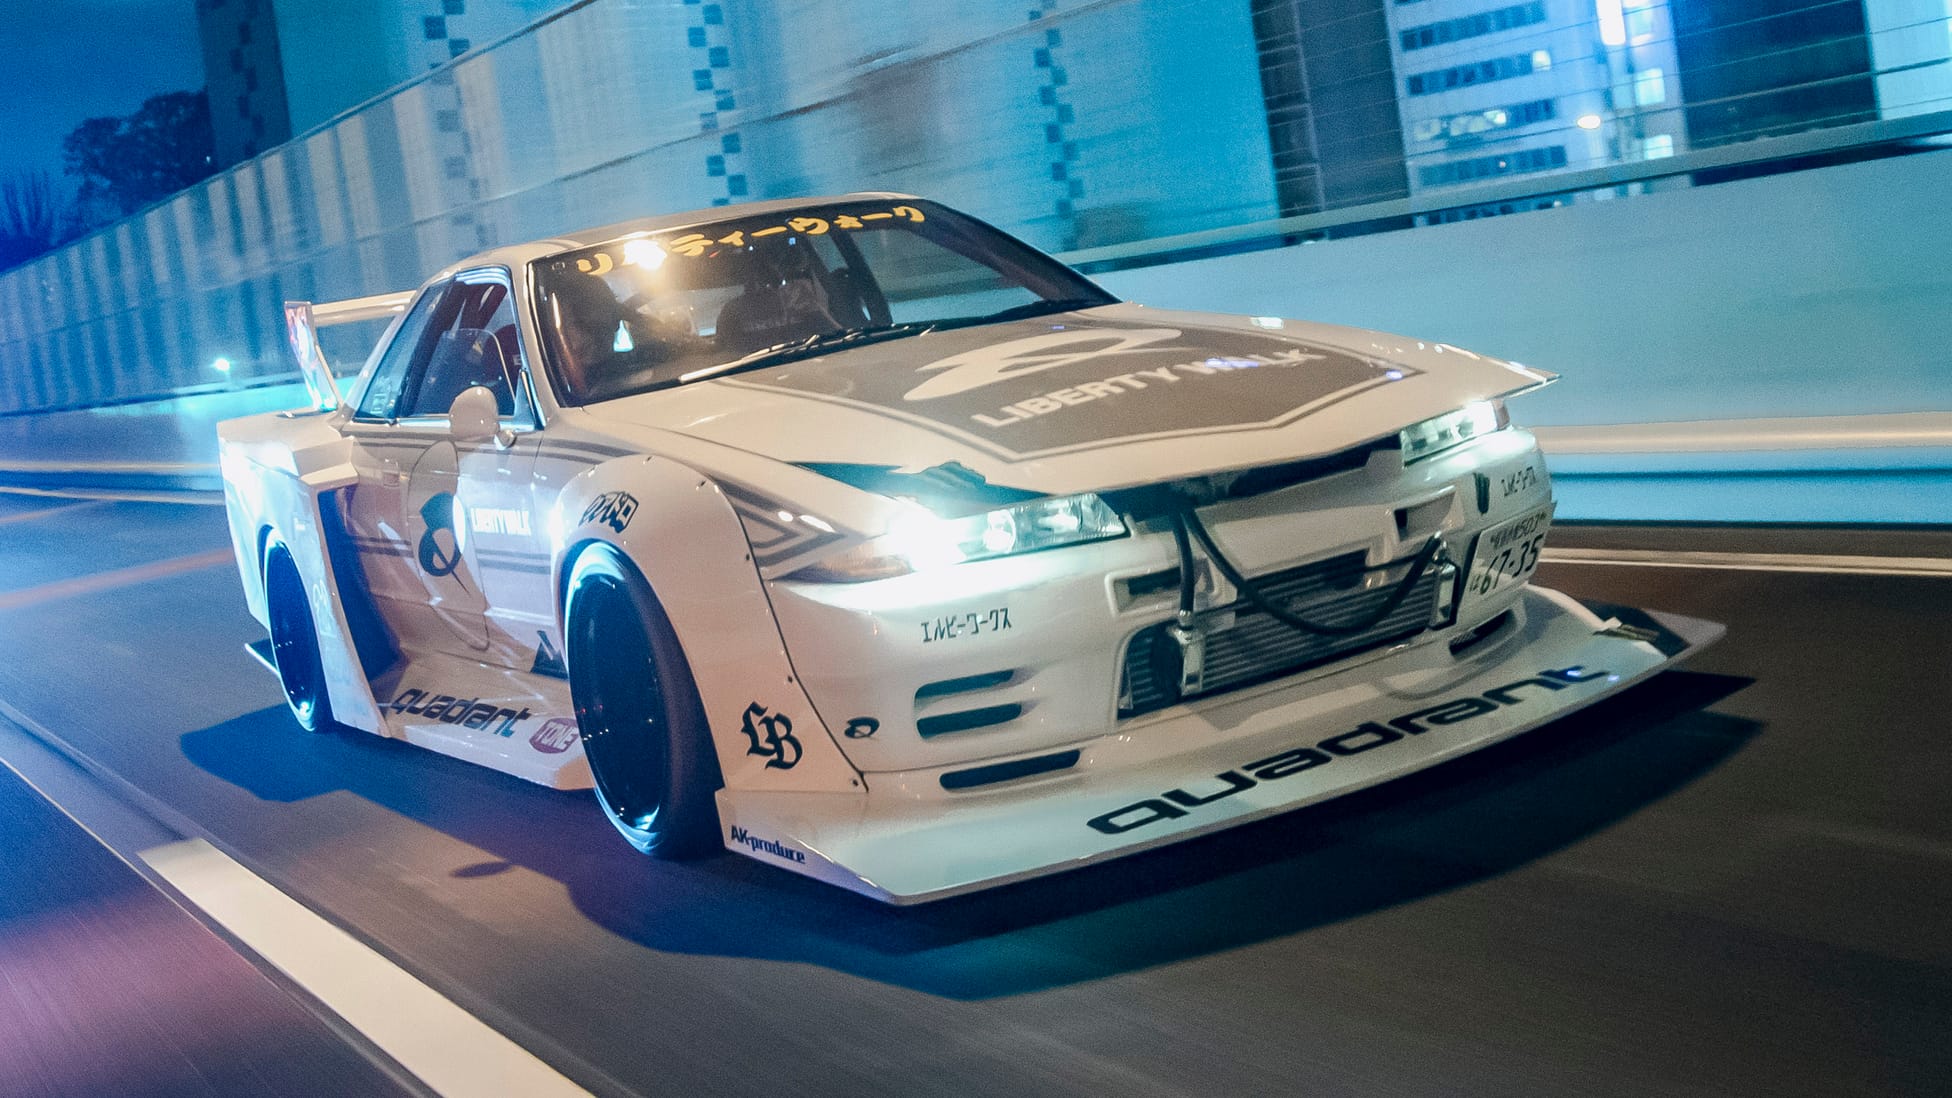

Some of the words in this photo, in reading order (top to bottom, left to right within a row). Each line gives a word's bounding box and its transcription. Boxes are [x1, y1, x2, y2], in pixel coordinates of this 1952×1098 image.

[576, 205, 926, 276] リティーウォーク
[970, 366, 1181, 428] LIBERTY
[389, 688, 532, 738] quadrant
[1086, 665, 1610, 836] quadrant
